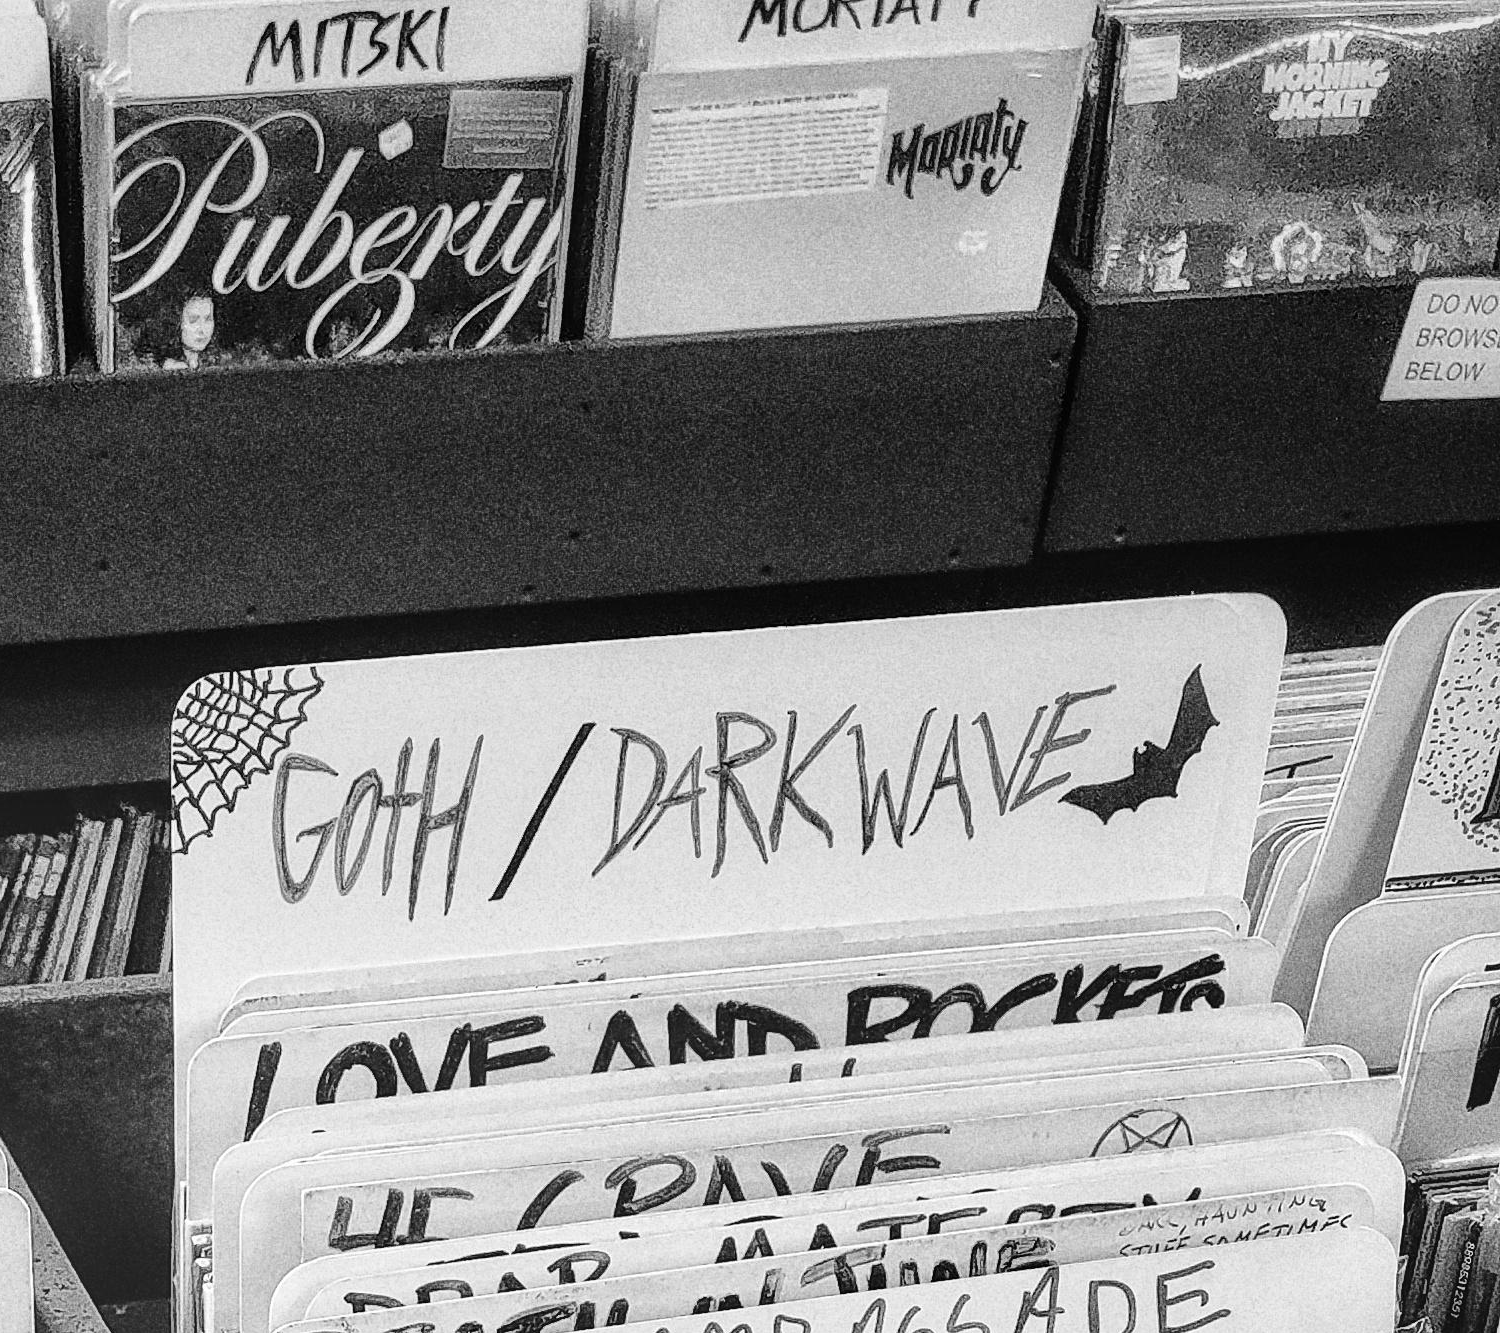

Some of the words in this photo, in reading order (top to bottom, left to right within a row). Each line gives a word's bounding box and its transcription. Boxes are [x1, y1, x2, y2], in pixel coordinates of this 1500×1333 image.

[245, 6, 450, 86] MITSKI
[110, 109, 566, 360] Puberty
[1427, 293, 1461, 314] DO
[1463, 294, 1499, 315] NO
[1416, 327, 1500, 349] BROWS
[1404, 361, 1487, 381] BELOW
[592, 684, 1118, 879] DARKWAVE
